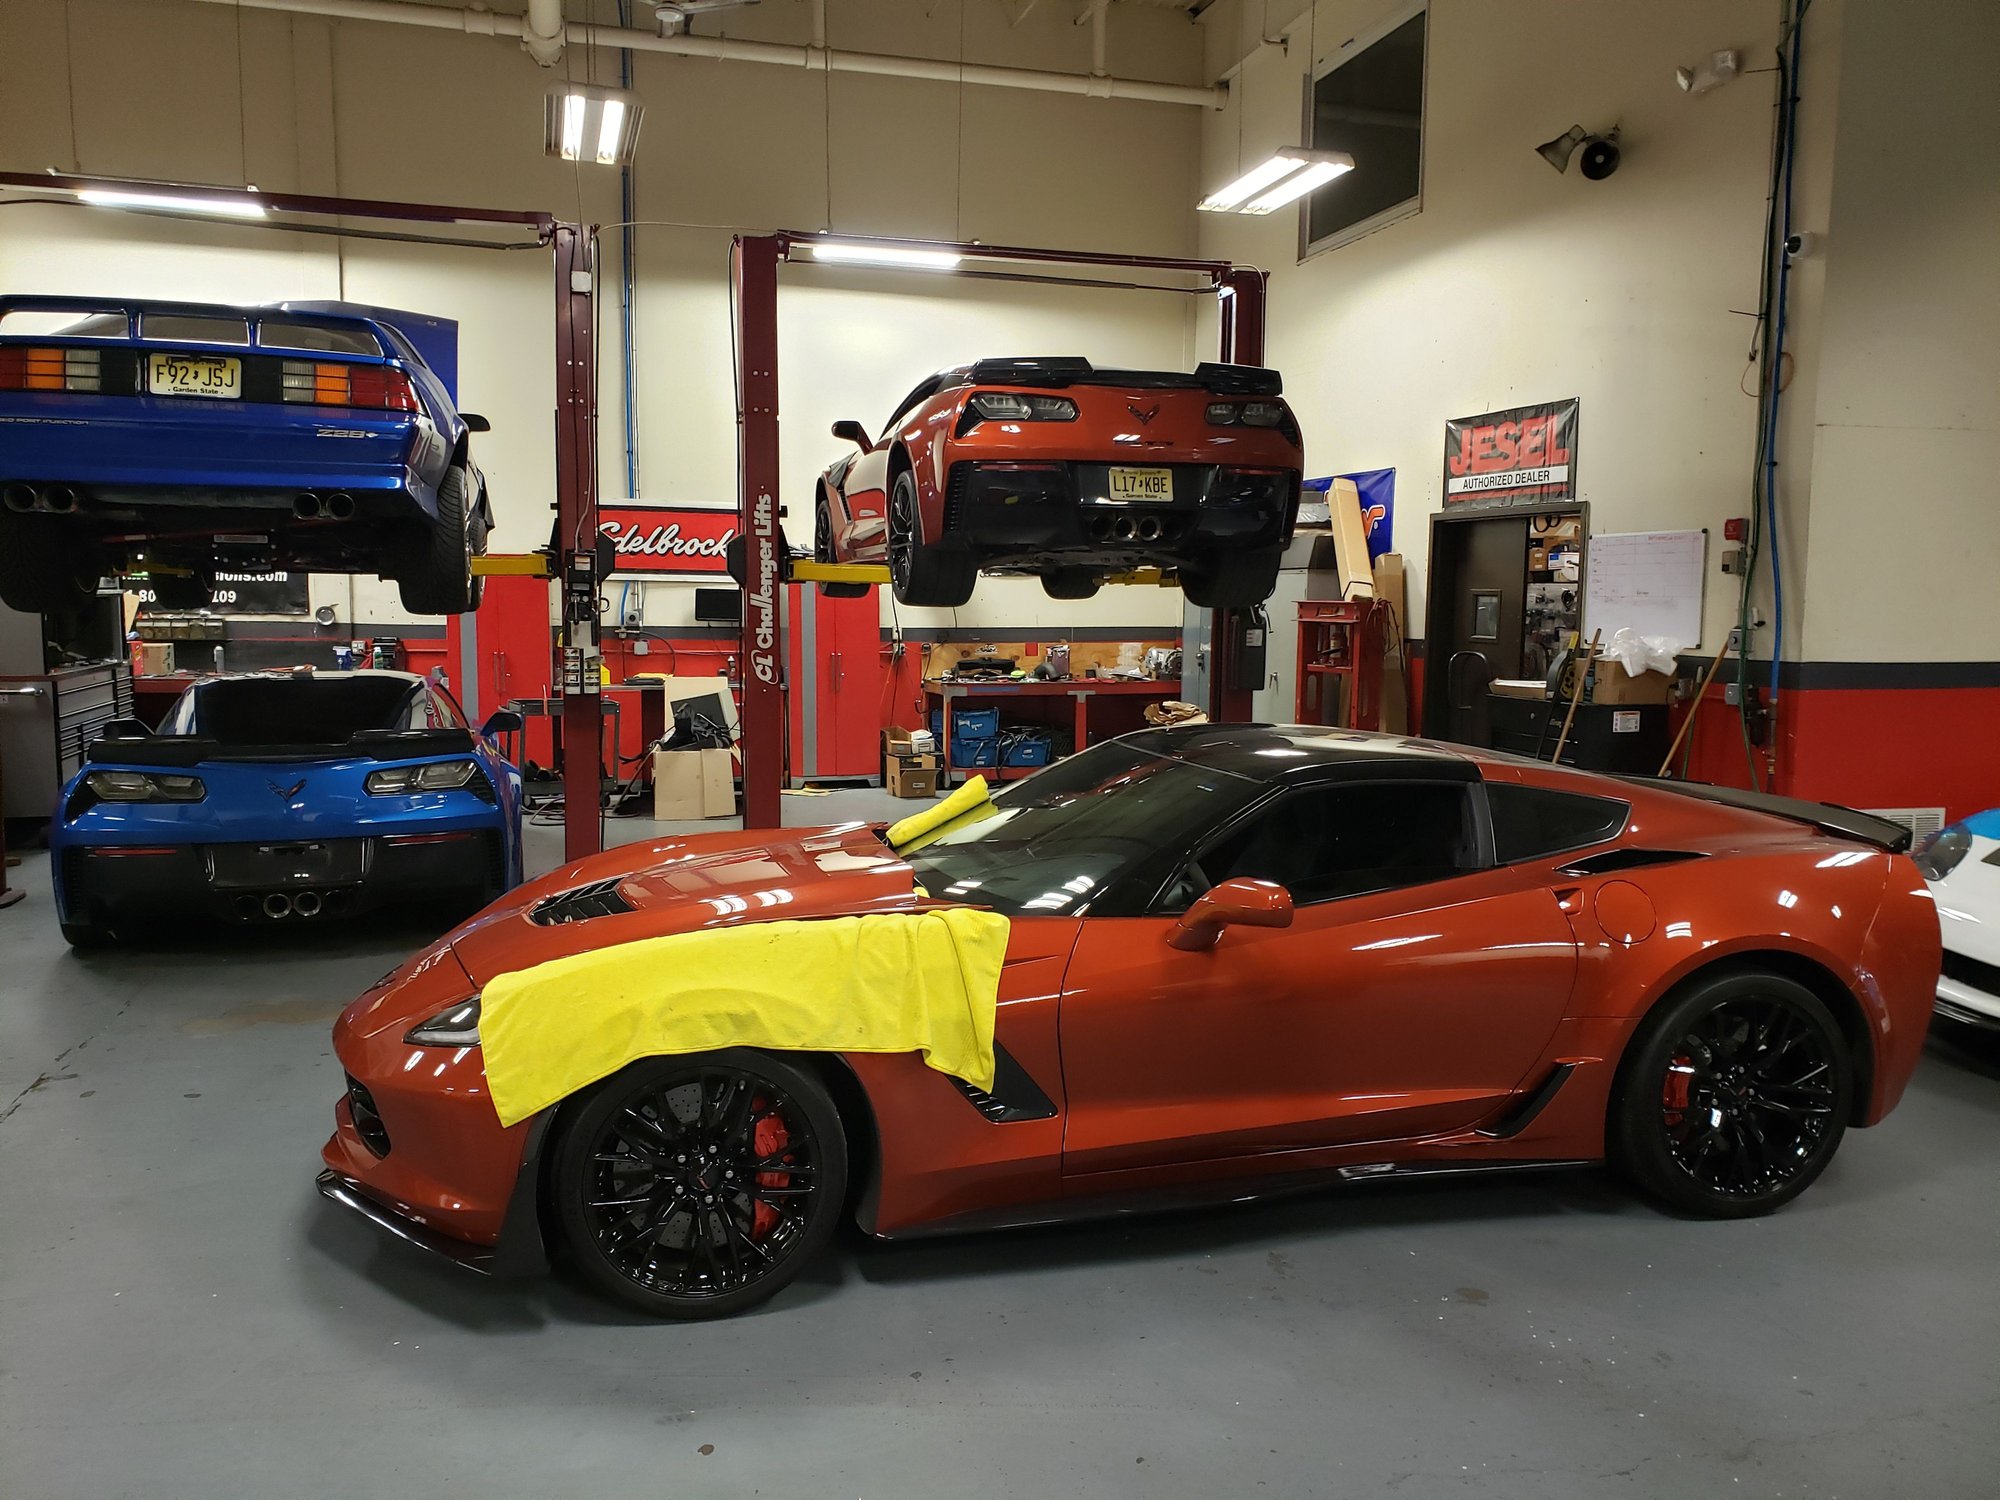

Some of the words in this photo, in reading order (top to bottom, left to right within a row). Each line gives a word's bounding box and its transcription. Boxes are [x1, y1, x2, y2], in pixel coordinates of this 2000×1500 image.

[156, 364, 190, 385] F92
[202, 367, 234, 388] JSJ
[172, 386, 198, 394] Garden
[200, 387, 219, 395] State
[1449, 414, 1570, 476] JESEL
[1113, 475, 1136, 493] L17
[1145, 476, 1168, 493] KBE
[1462, 474, 1514, 490] AUTHORIZED
[1515, 470, 1550, 485] DEALER
[753, 493, 773, 536] Lifts
[750, 539, 778, 649] Challenger
